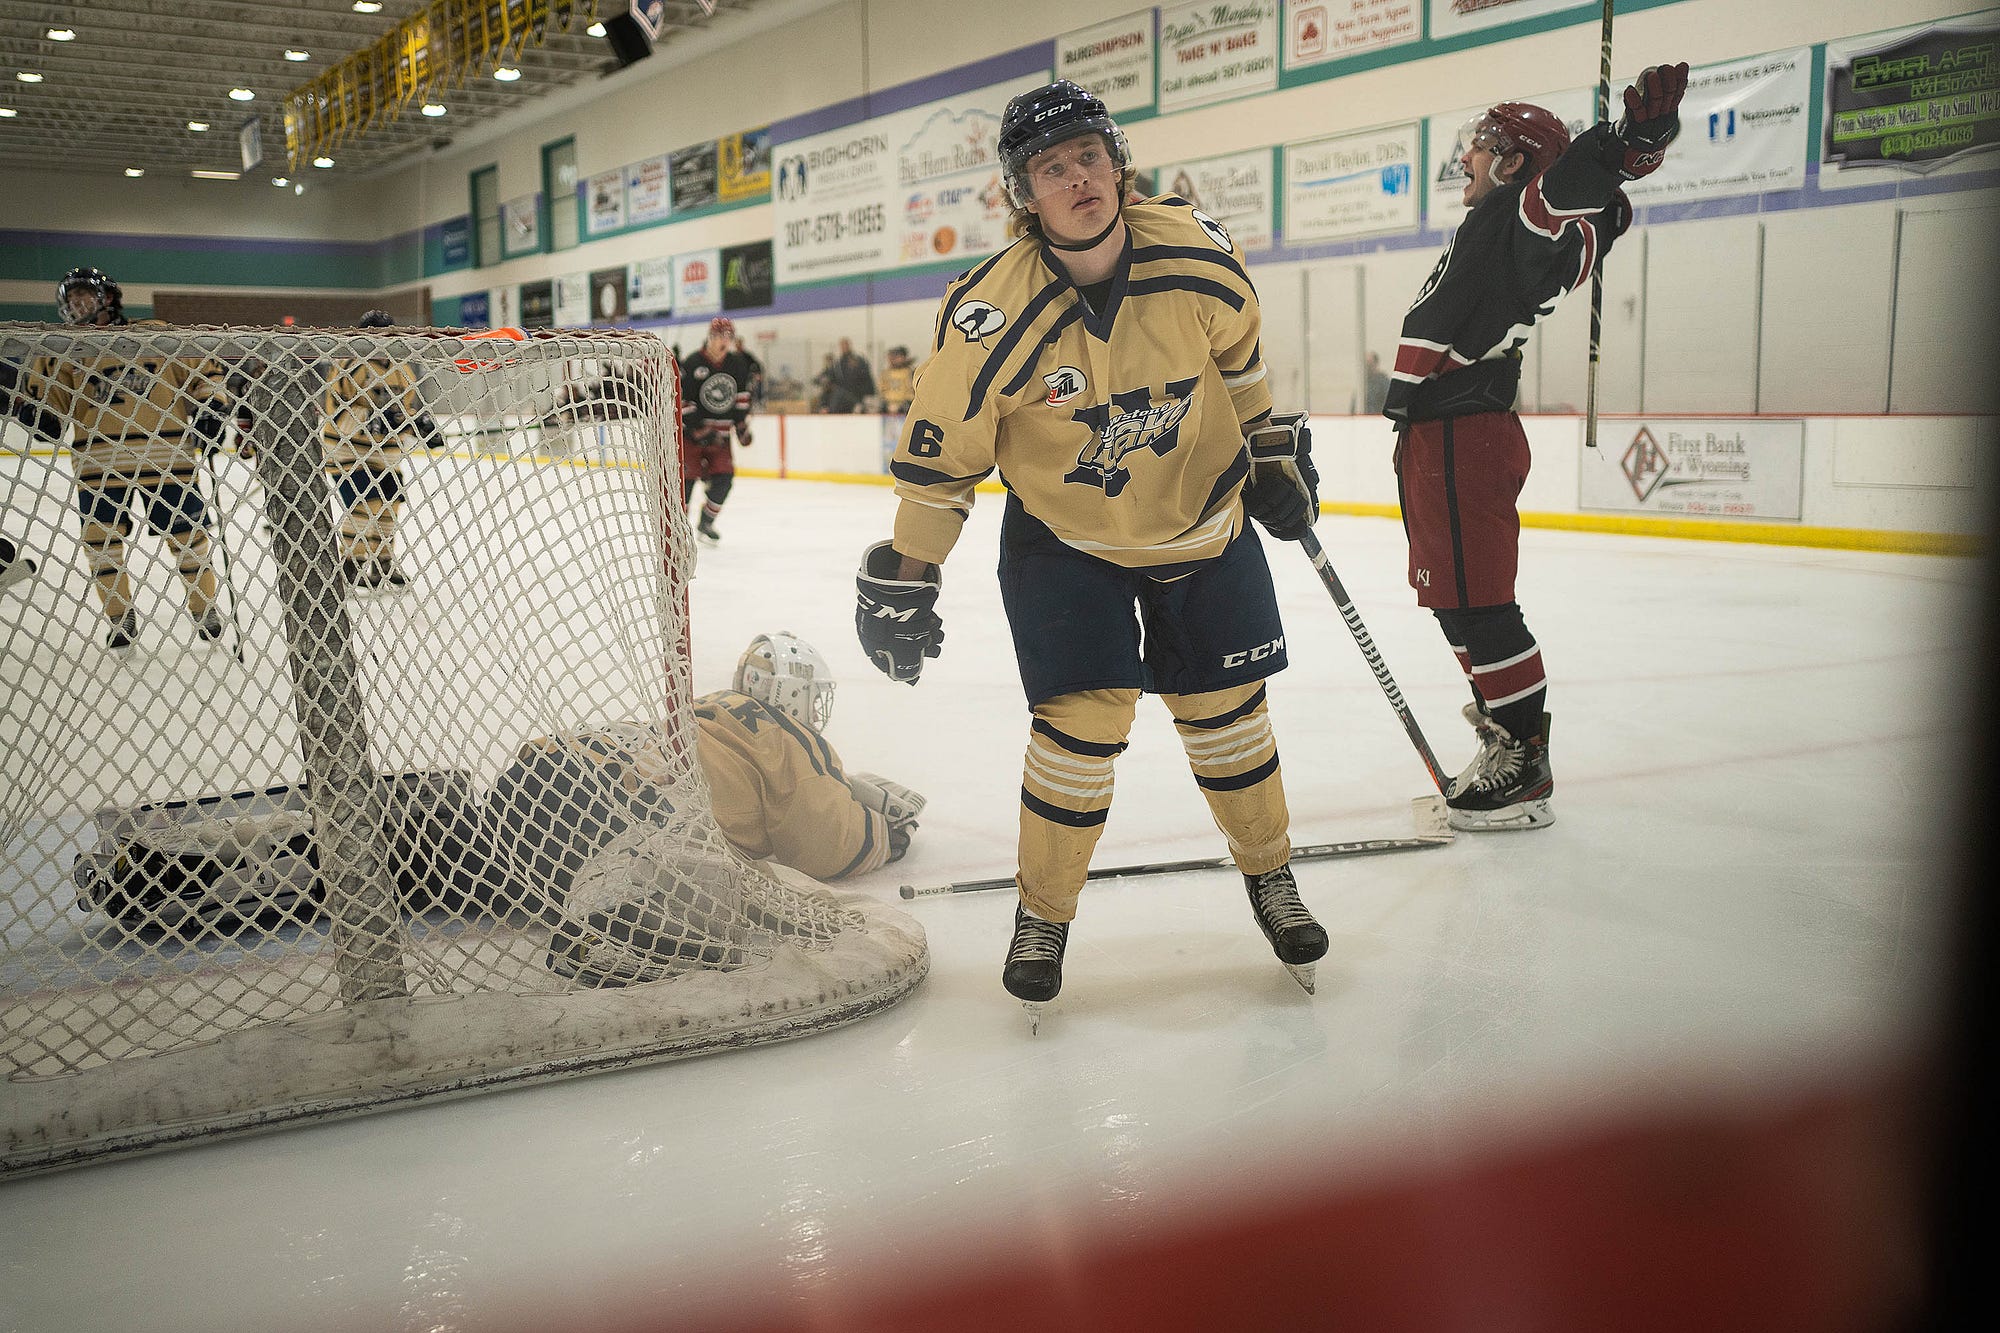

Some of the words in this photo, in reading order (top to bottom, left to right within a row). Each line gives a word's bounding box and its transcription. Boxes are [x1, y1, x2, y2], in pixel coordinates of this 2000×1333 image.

[1034, 102, 1073, 123] CCM
[1928, 101, 1942, 126] Big
[1943, 102, 1951, 116] to
[1980, 92, 1994, 111] We
[809, 132, 889, 171] BIGHORN
[1519, 134, 1543, 149] CCM
[908, 419, 945, 458] 6
[1668, 431, 1701, 453] First
[1704, 431, 1745, 453] Bank
[1687, 453, 1750, 479] Wyoming
[1222, 635, 1284, 669] CCM
[1339, 600, 1407, 712] WARRIOR
[917, 885, 953, 896] FOCUS
